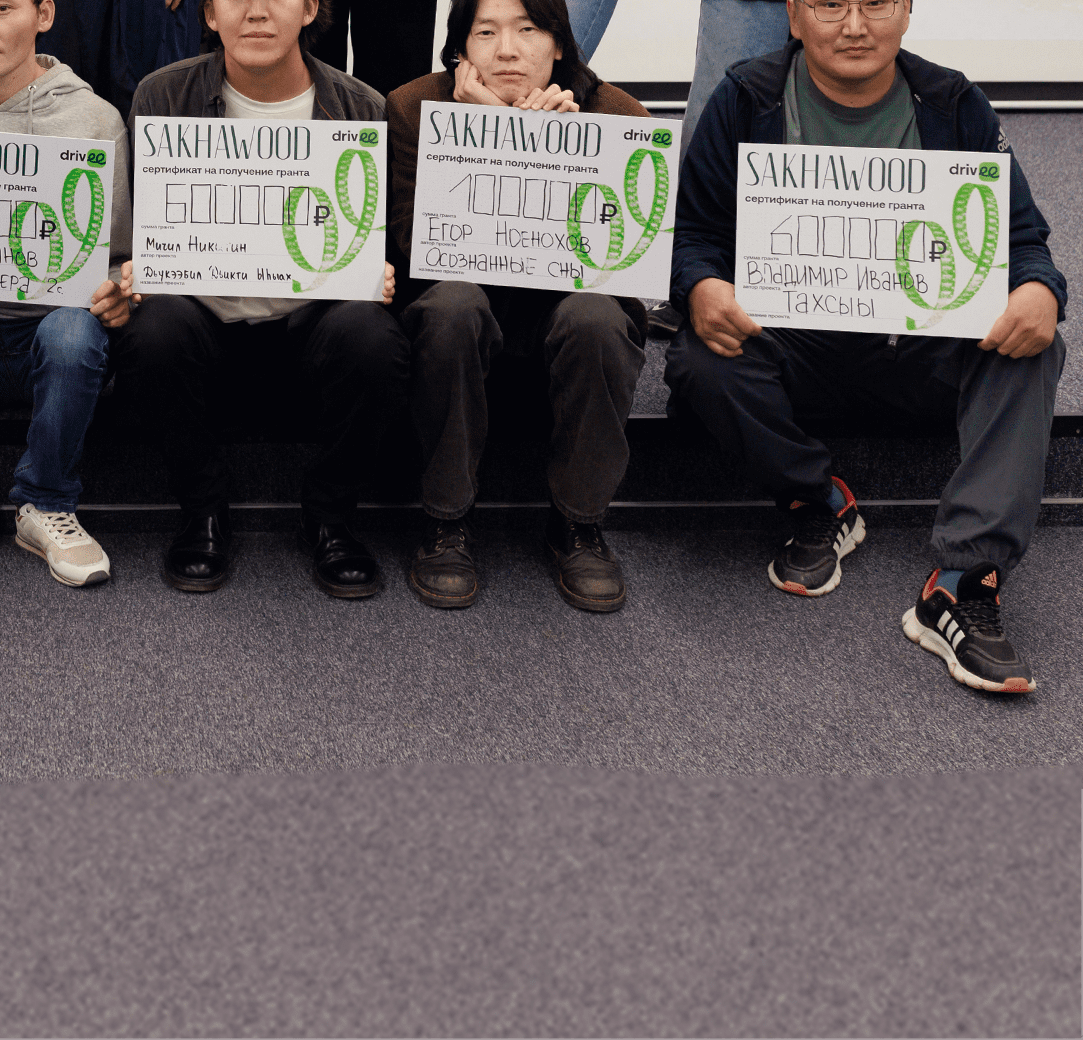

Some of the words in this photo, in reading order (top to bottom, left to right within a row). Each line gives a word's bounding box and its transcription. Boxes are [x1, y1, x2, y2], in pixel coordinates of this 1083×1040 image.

[143, 123, 311, 160] SAKHAWOOD
[332, 130, 378, 144] drivee
[428, 110, 602, 158] SAKHAWOOD
[624, 129, 672, 146] drivee
[60, 150, 106, 166] drivee
[427, 152, 488, 165] сертификат
[490, 158, 502, 166] на
[505, 158, 561, 172] получение
[563, 164, 599, 174] гранта
[143, 166, 203, 175] сертификат
[219, 167, 274, 176] получение
[276, 168, 310, 178] гранта
[745, 151, 926, 194] SAKHAWOOD
[949, 164, 1000, 179] drivee
[4, 183, 37, 193] гранта
[745, 195, 809, 206] сертификат
[811, 198, 824, 206] на
[827, 198, 885, 209] получение
[888, 201, 925, 210] гранта
